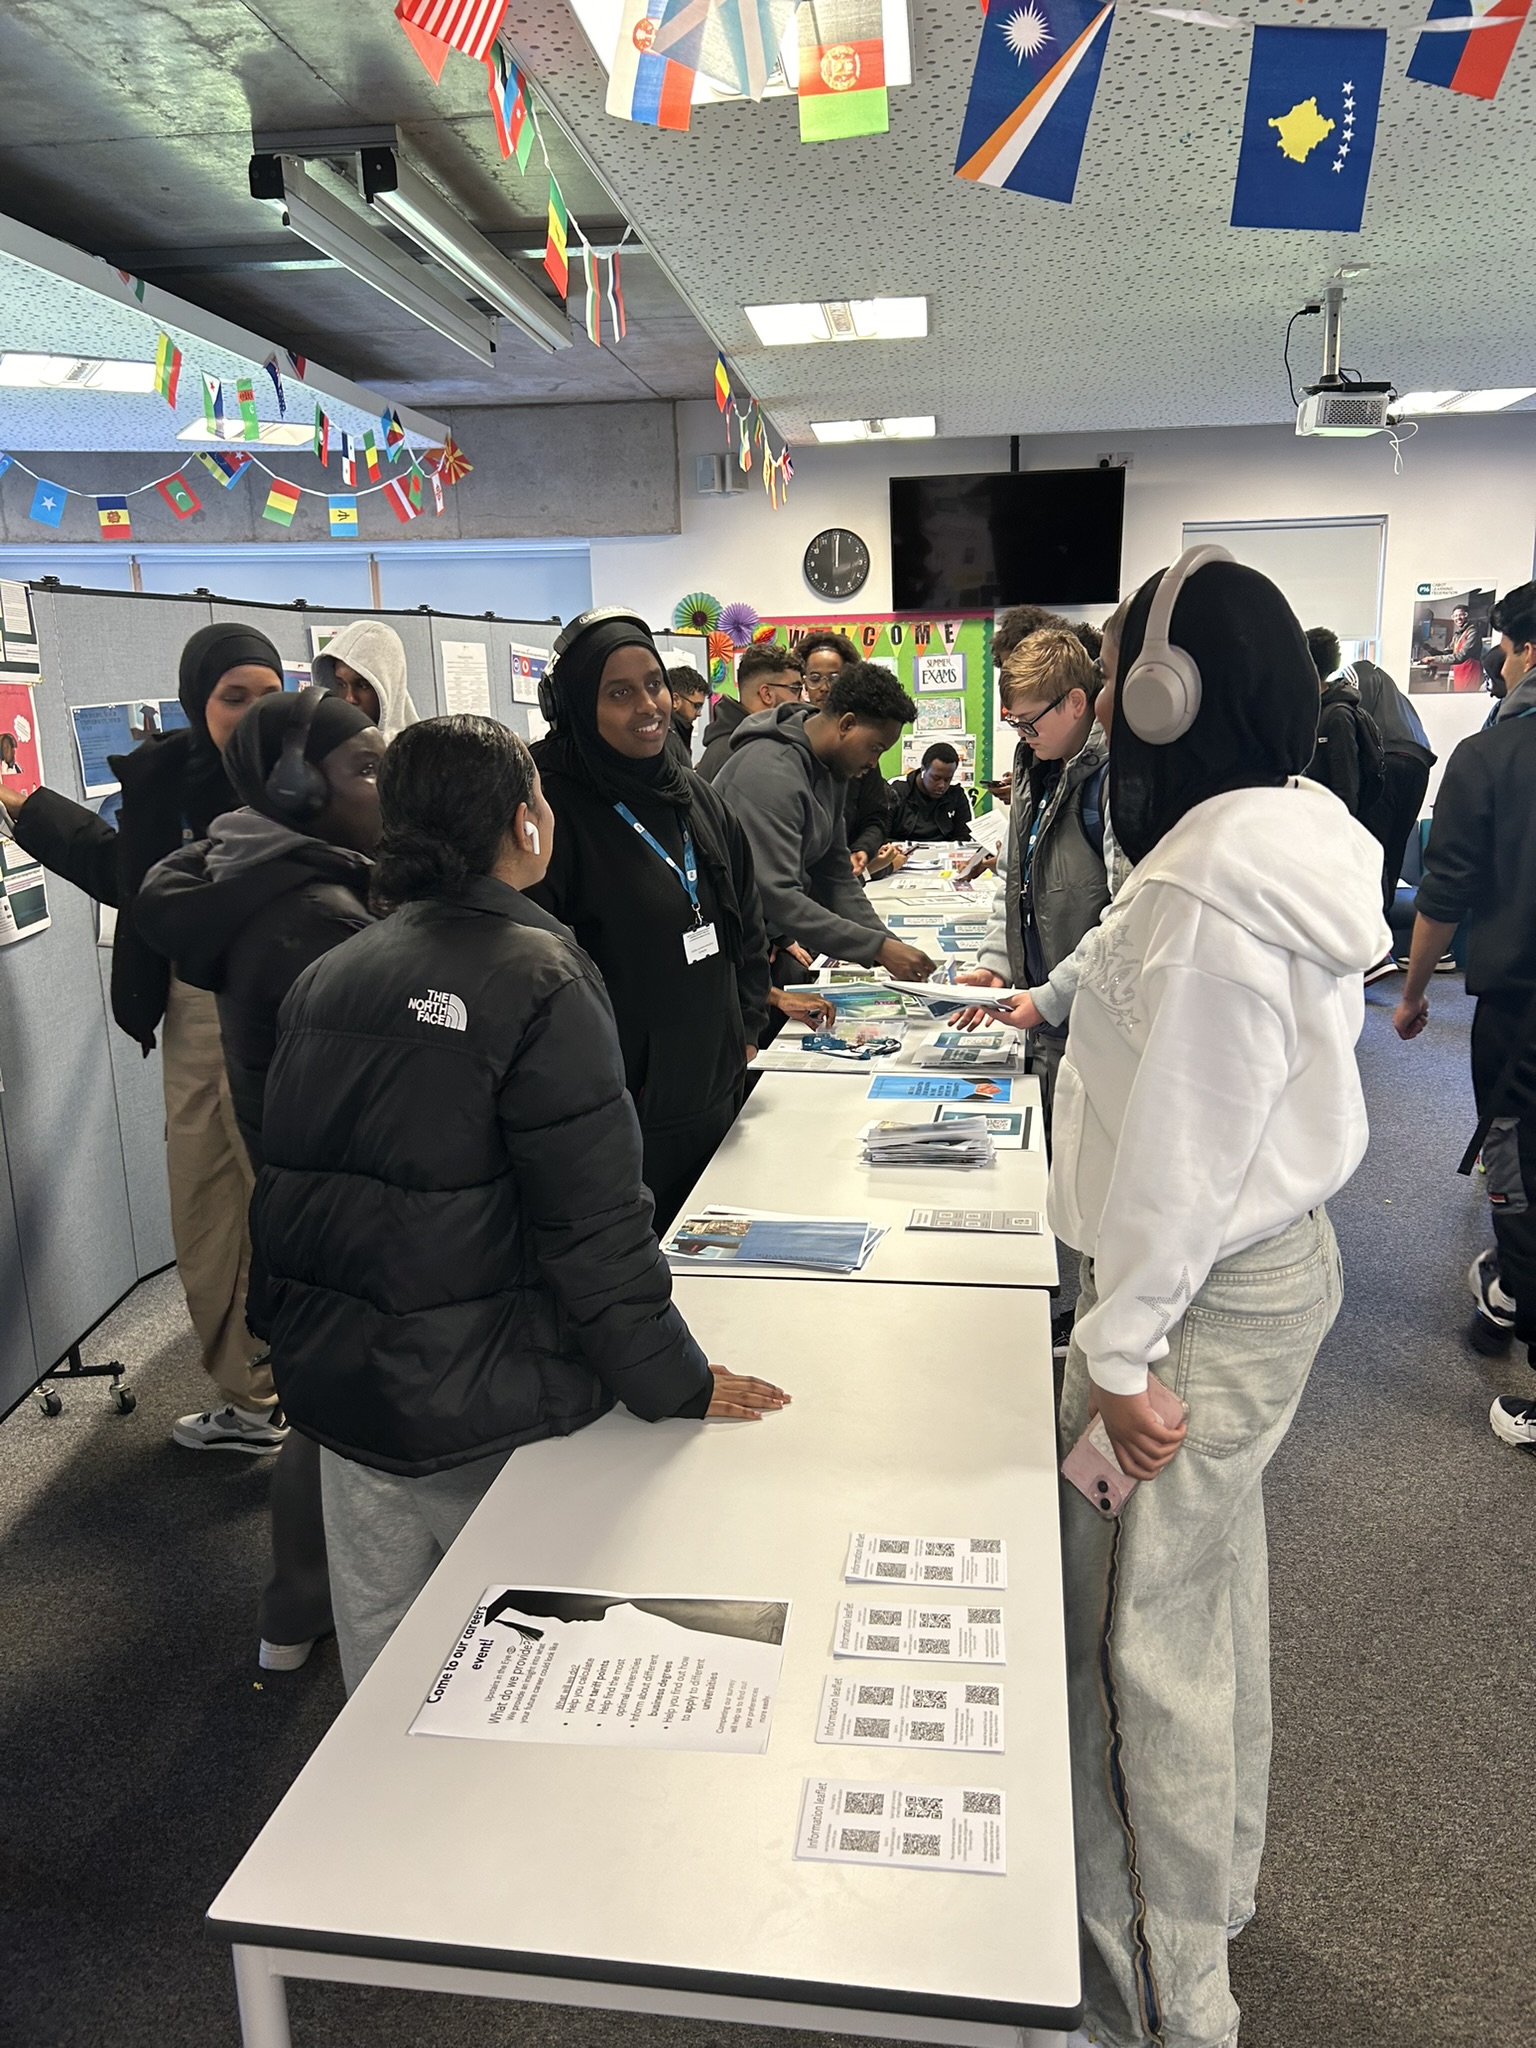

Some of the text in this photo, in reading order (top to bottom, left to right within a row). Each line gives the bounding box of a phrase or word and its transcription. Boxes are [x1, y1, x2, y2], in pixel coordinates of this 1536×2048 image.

[789, 624, 954, 649] WCOME
[922, 669, 957, 685] EXAMS
[407, 997, 448, 1016] NORTH
[427, 989, 450, 1004] THE
[416, 1010, 446, 1026] FACE
[426, 1606, 487, 1704] Come to our careers
[472, 1638, 494, 1670] event!
[540, 1662, 551, 1676] could
[690, 1659, 706, 1686] different
[488, 1641, 534, 1724] What do we provide?
[512, 1691, 526, 1711] provide
[565, 1658, 595, 1713] Help you calculate
[584, 1698, 596, 1712] your
[597, 1660, 610, 1680] points
[598, 1659, 626, 1714] Help find the most
[616, 1657, 642, 1717] optimal universities
[629, 1654, 659, 1721] Inform about different
[647, 1661, 673, 1716] business degrees
[663, 1656, 690, 1723] Help you find out how
[702, 1672, 718, 1710] universities
[685, 1695, 699, 1713] apply
[824, 1698, 839, 1736] Information
[807, 1782, 828, 1849] Information leaflet
